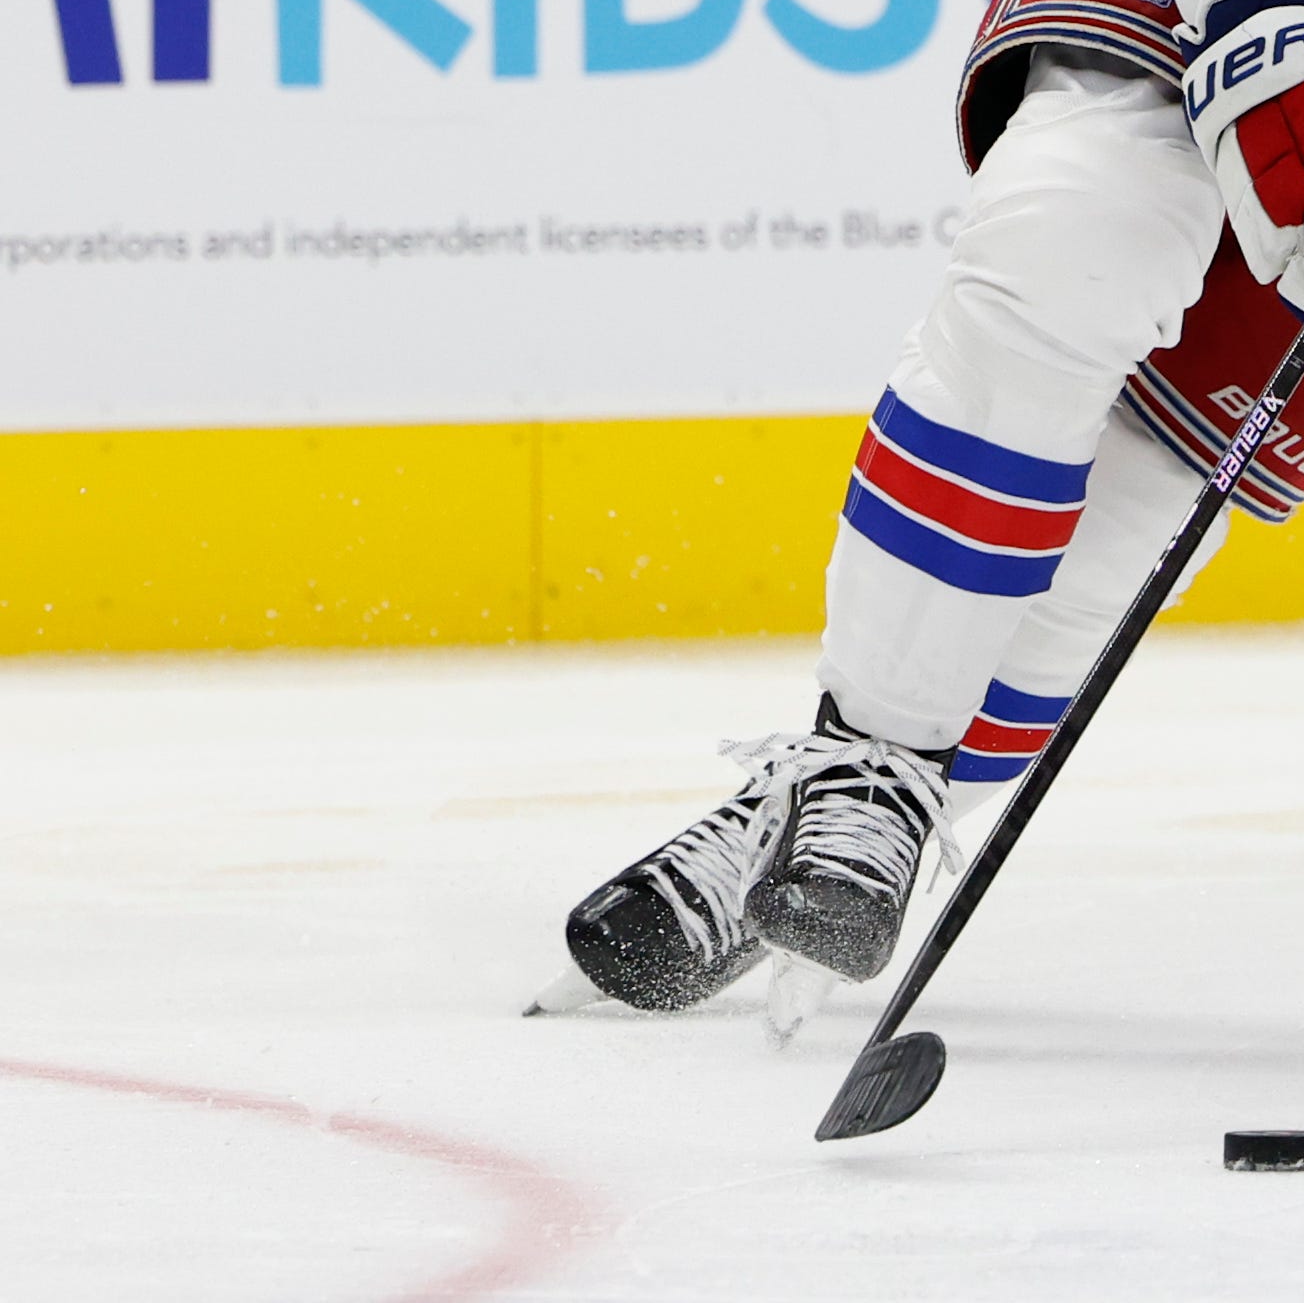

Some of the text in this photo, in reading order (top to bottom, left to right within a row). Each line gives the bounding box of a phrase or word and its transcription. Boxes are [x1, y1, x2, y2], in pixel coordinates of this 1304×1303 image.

[201, 216, 275, 261] and
[284, 215, 529, 268] independent
[538, 213, 711, 254] licensees
[719, 208, 760, 252] of
[768, 211, 830, 251] the
[840, 208, 923, 250] Blue
